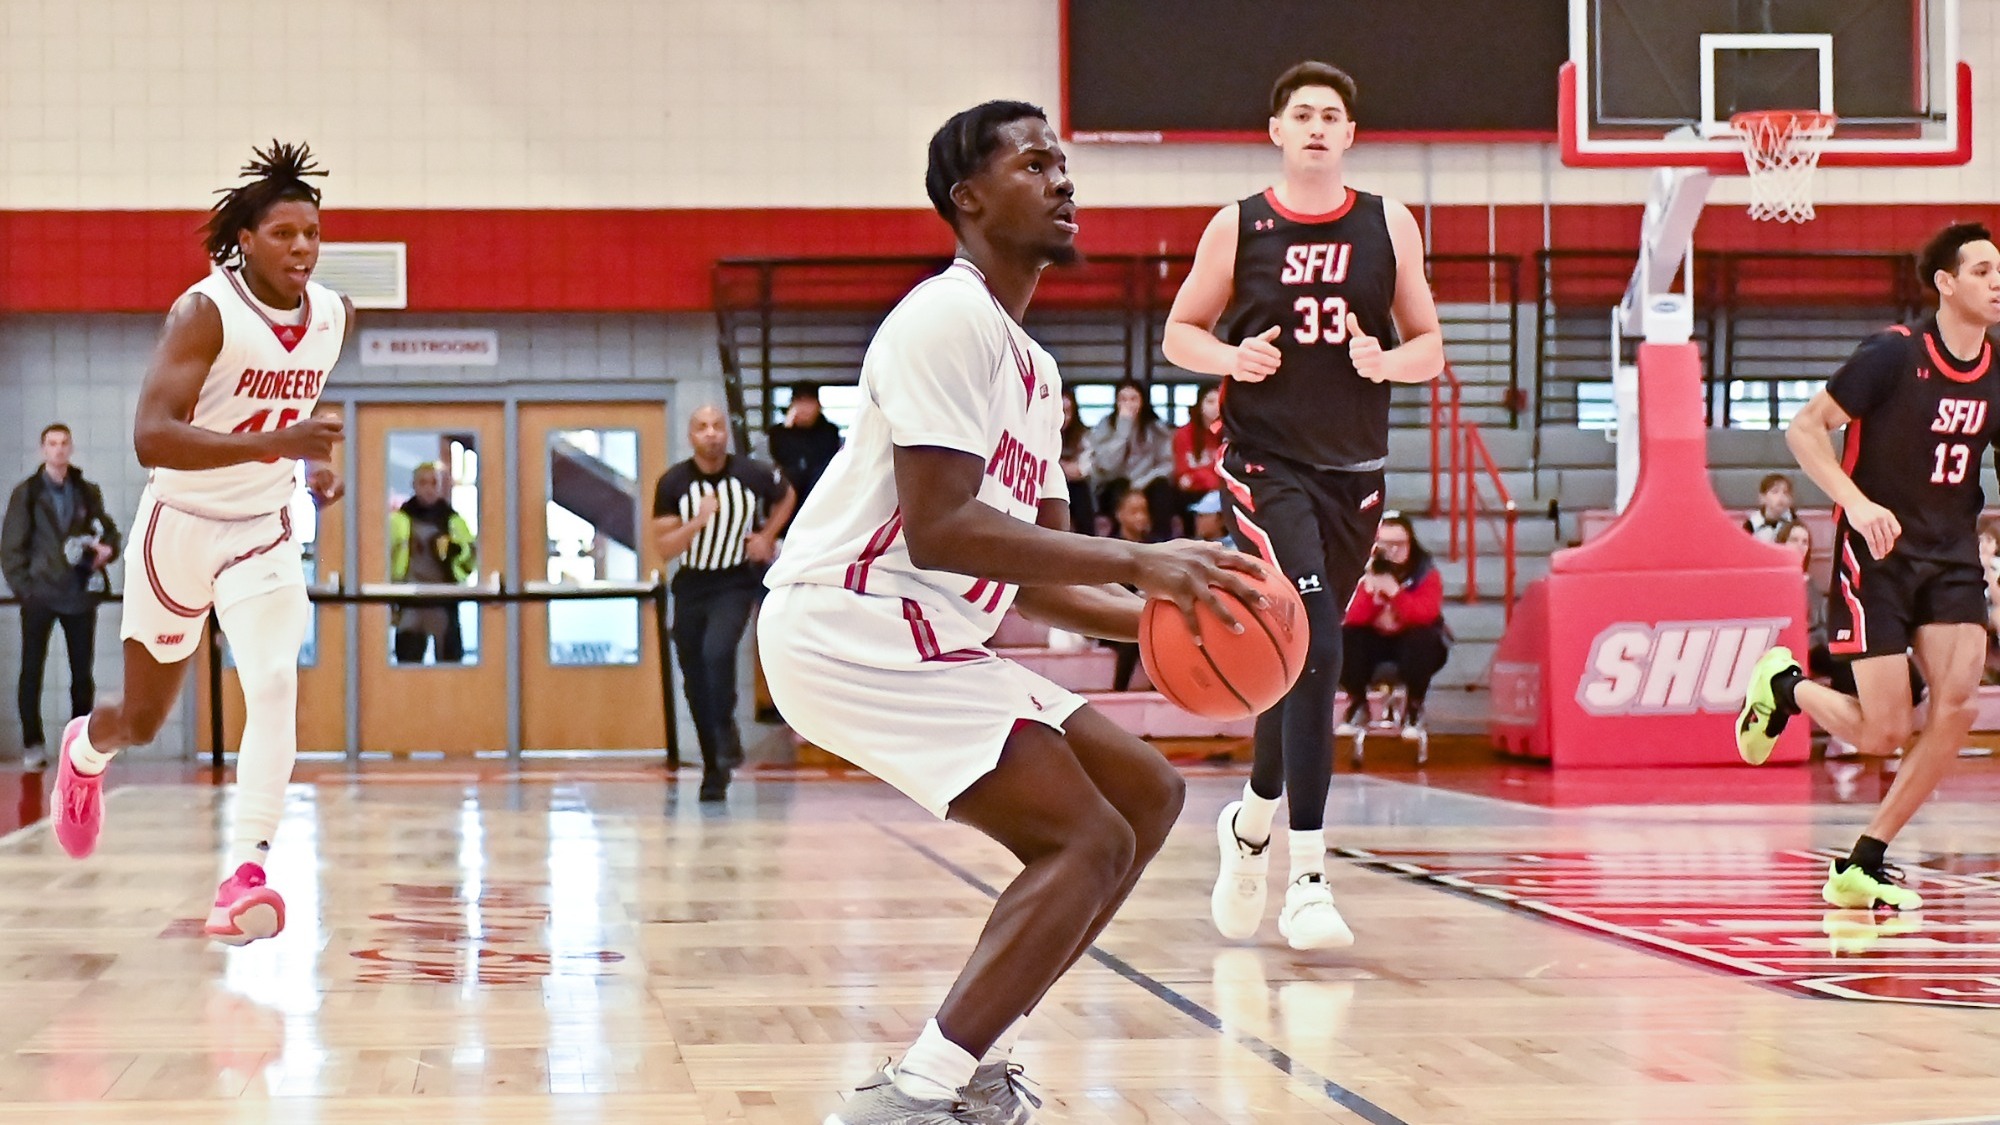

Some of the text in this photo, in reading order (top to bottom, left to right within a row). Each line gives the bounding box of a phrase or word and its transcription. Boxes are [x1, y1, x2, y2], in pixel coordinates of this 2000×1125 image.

[1281, 243, 1352, 285] SFU
[1293, 296, 1347, 344] 33
[391, 340, 488, 353] RESTROOMS
[234, 368, 324, 399] PIONEERS
[1930, 398, 1988, 435] SFU
[1930, 442, 1970, 483] 13
[1576, 617, 1791, 717] SHU
